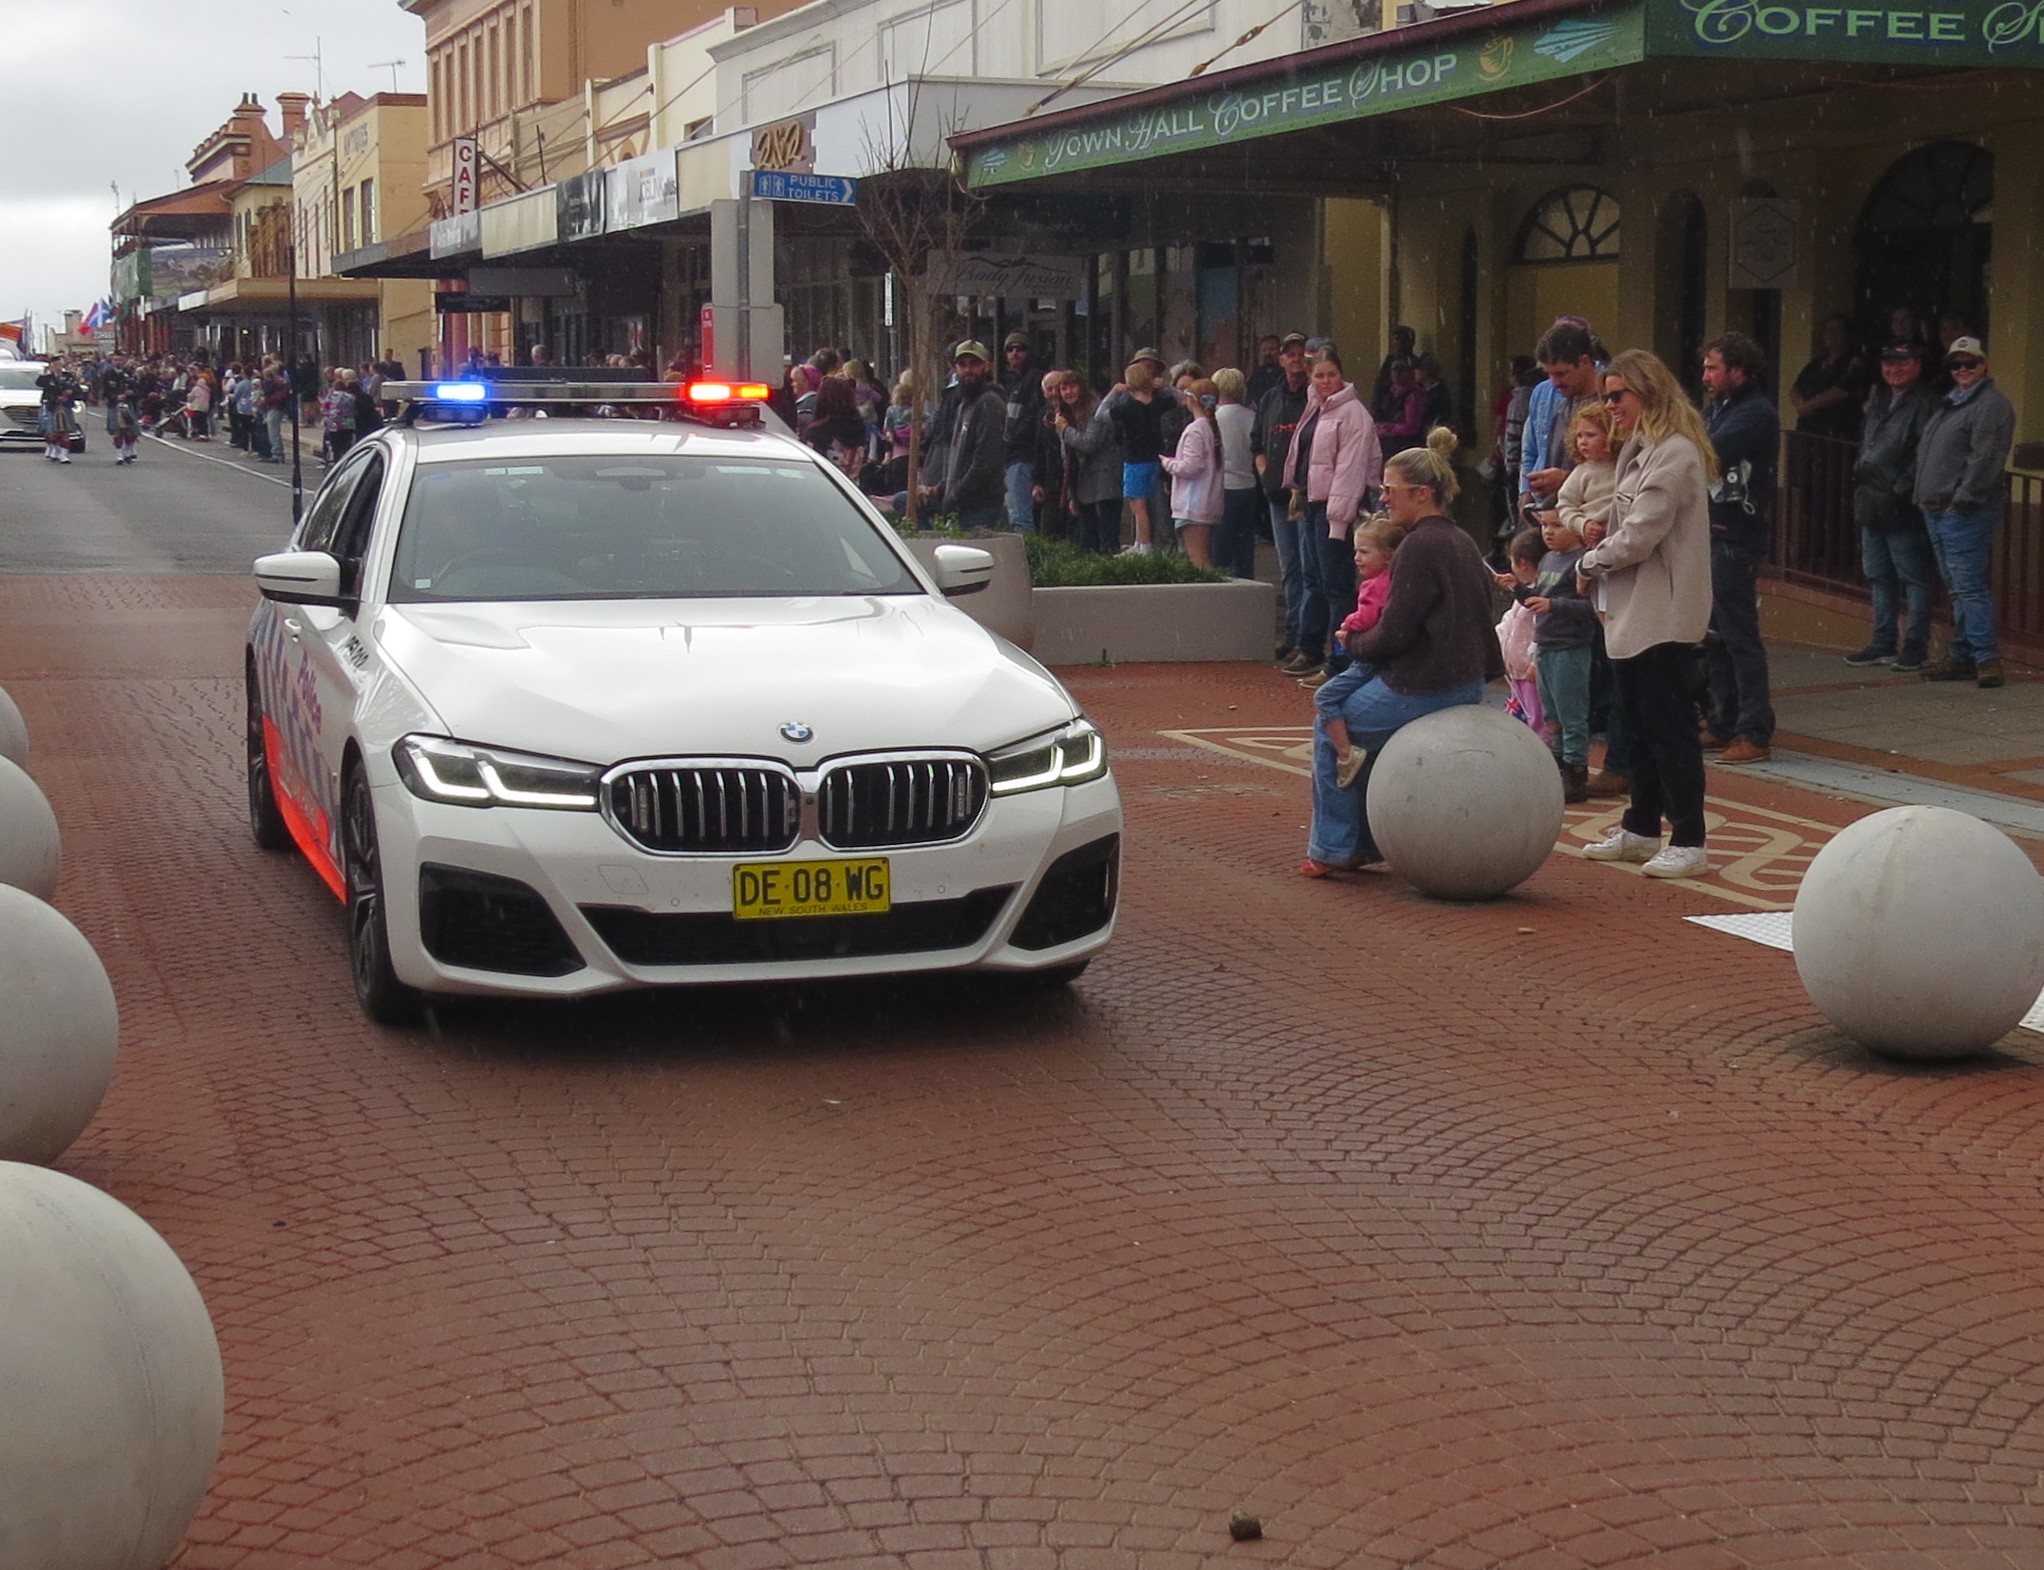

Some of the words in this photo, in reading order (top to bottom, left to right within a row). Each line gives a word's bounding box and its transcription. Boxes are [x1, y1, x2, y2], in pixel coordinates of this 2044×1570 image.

[1679, 0, 1966, 43] COFFEE
[1045, 126, 1121, 167] TOWN
[1125, 107, 1204, 150] HALL
[1207, 79, 1343, 136] COFFEE
[1349, 53, 1457, 109] SHOP
[458, 145, 473, 214] CAF
[790, 175, 836, 189] PUBLIC
[787, 188, 839, 202] TOILETS
[758, 906, 784, 916] NEW
[788, 904, 826, 915] SOUTH
[832, 902, 868, 913] WALES
